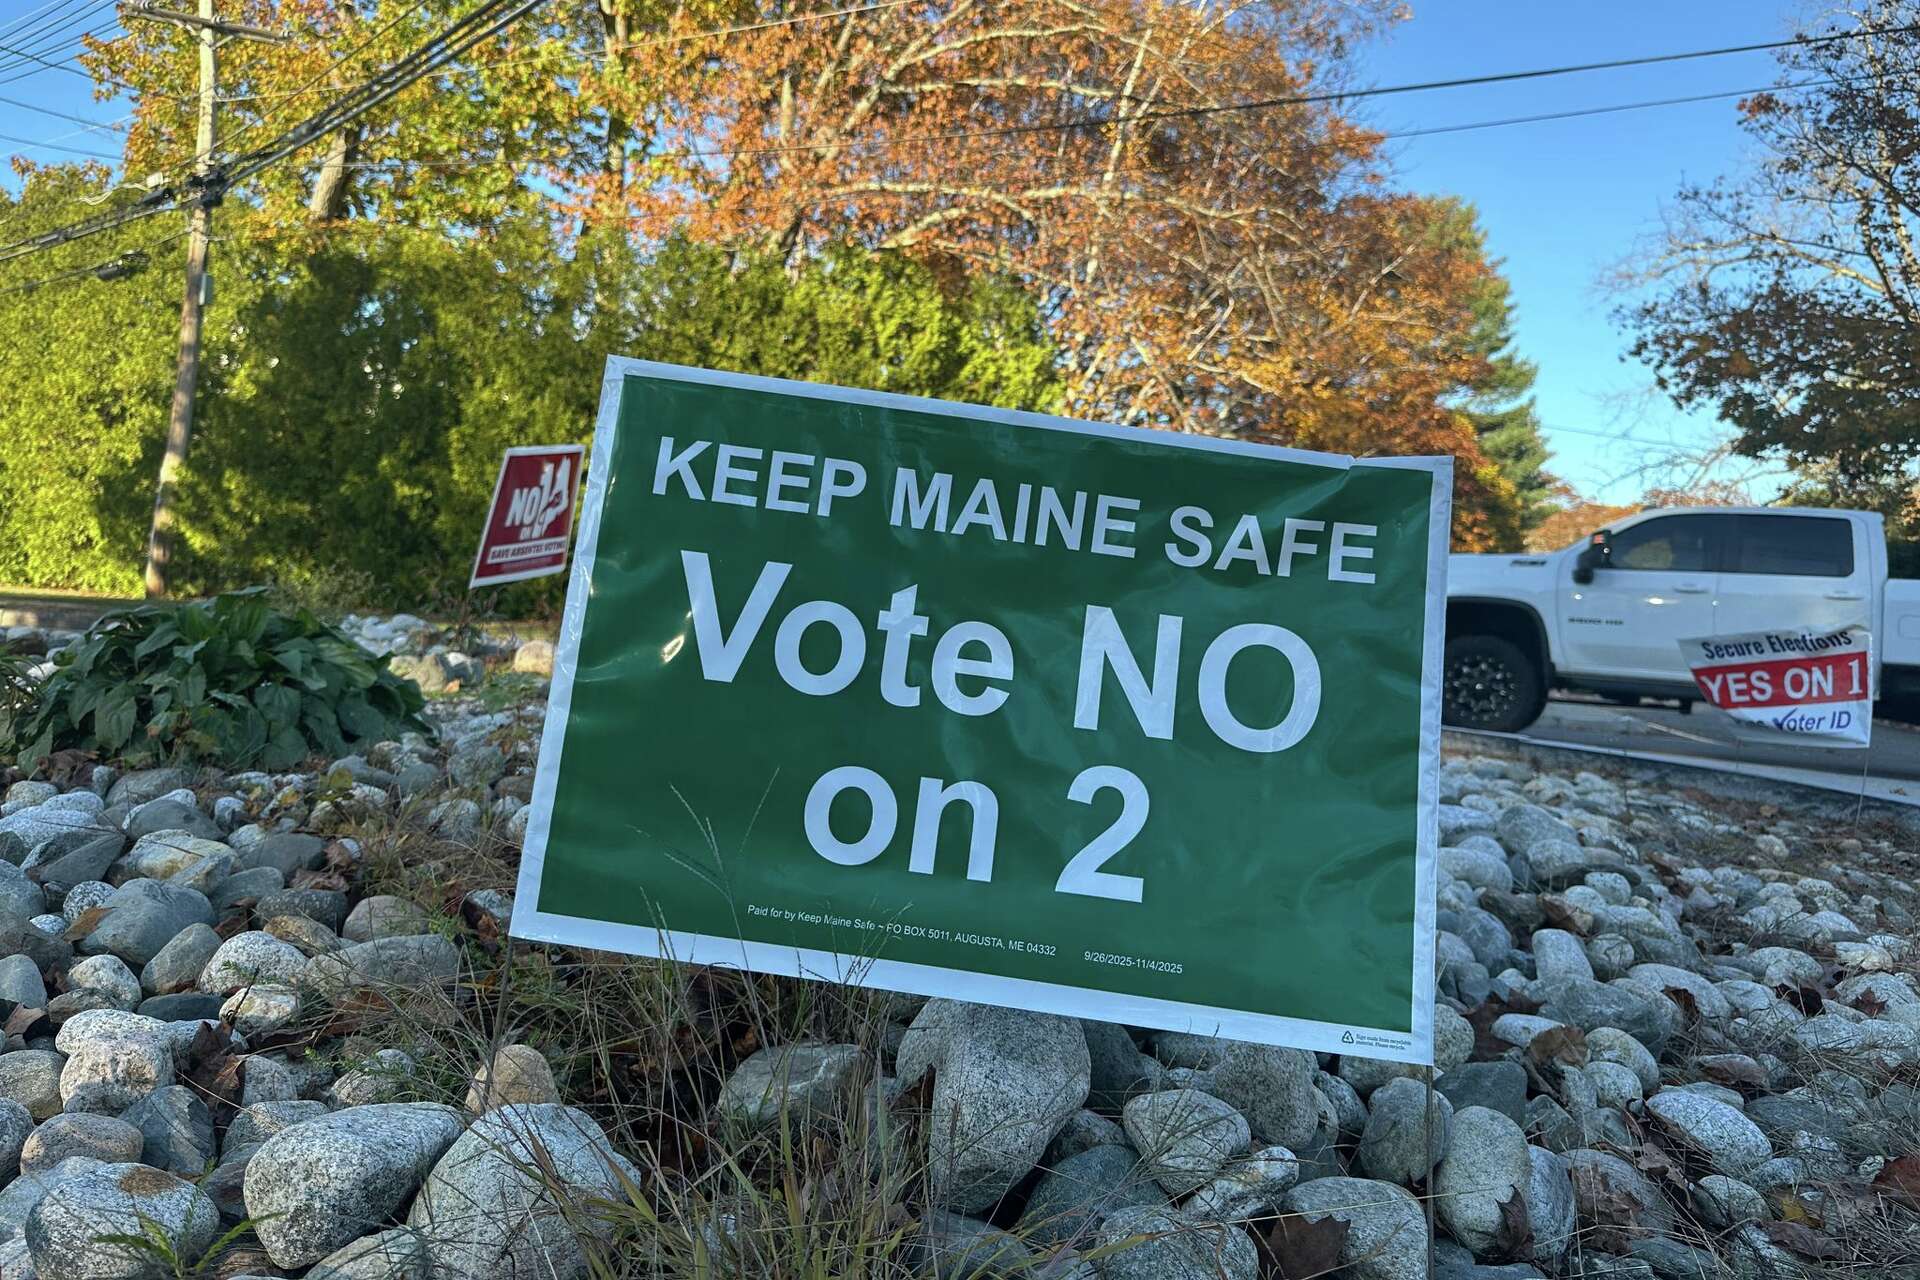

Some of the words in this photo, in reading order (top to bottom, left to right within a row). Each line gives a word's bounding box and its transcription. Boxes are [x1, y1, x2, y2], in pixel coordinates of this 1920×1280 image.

[505, 487, 541, 527] NO
[653, 436, 867, 517] KEEP
[890, 467, 1141, 559] MAINE
[1164, 506, 1378, 585] SAFE
[681, 550, 1014, 716] Vote
[1073, 604, 1322, 753] NO
[1701, 641, 1765, 660] Secure
[1766, 630, 1852, 654] Elections
[1700, 669, 1773, 705] YES
[1783, 664, 1833, 700] ON
[1848, 659, 1863, 695] 1
[1830, 711, 1851, 729] ID
[805, 766, 999, 884] on
[1054, 765, 1150, 904] 2
[747, 904, 768, 916] Paid
[770, 907, 783, 918] for
[784, 909, 796, 922] by
[797, 911, 822, 925] Keep
[823, 914, 852, 928] Maine
[853, 918, 876, 931] Safe
[903, 925, 926, 937] BOX
[954, 932, 1006, 950] AUGUSTA,
[1008, 939, 1025, 952] ME
[1026, 942, 1057, 956] 04332
[1084, 951, 1184, 974] 9/26/2025-11/4/2025
